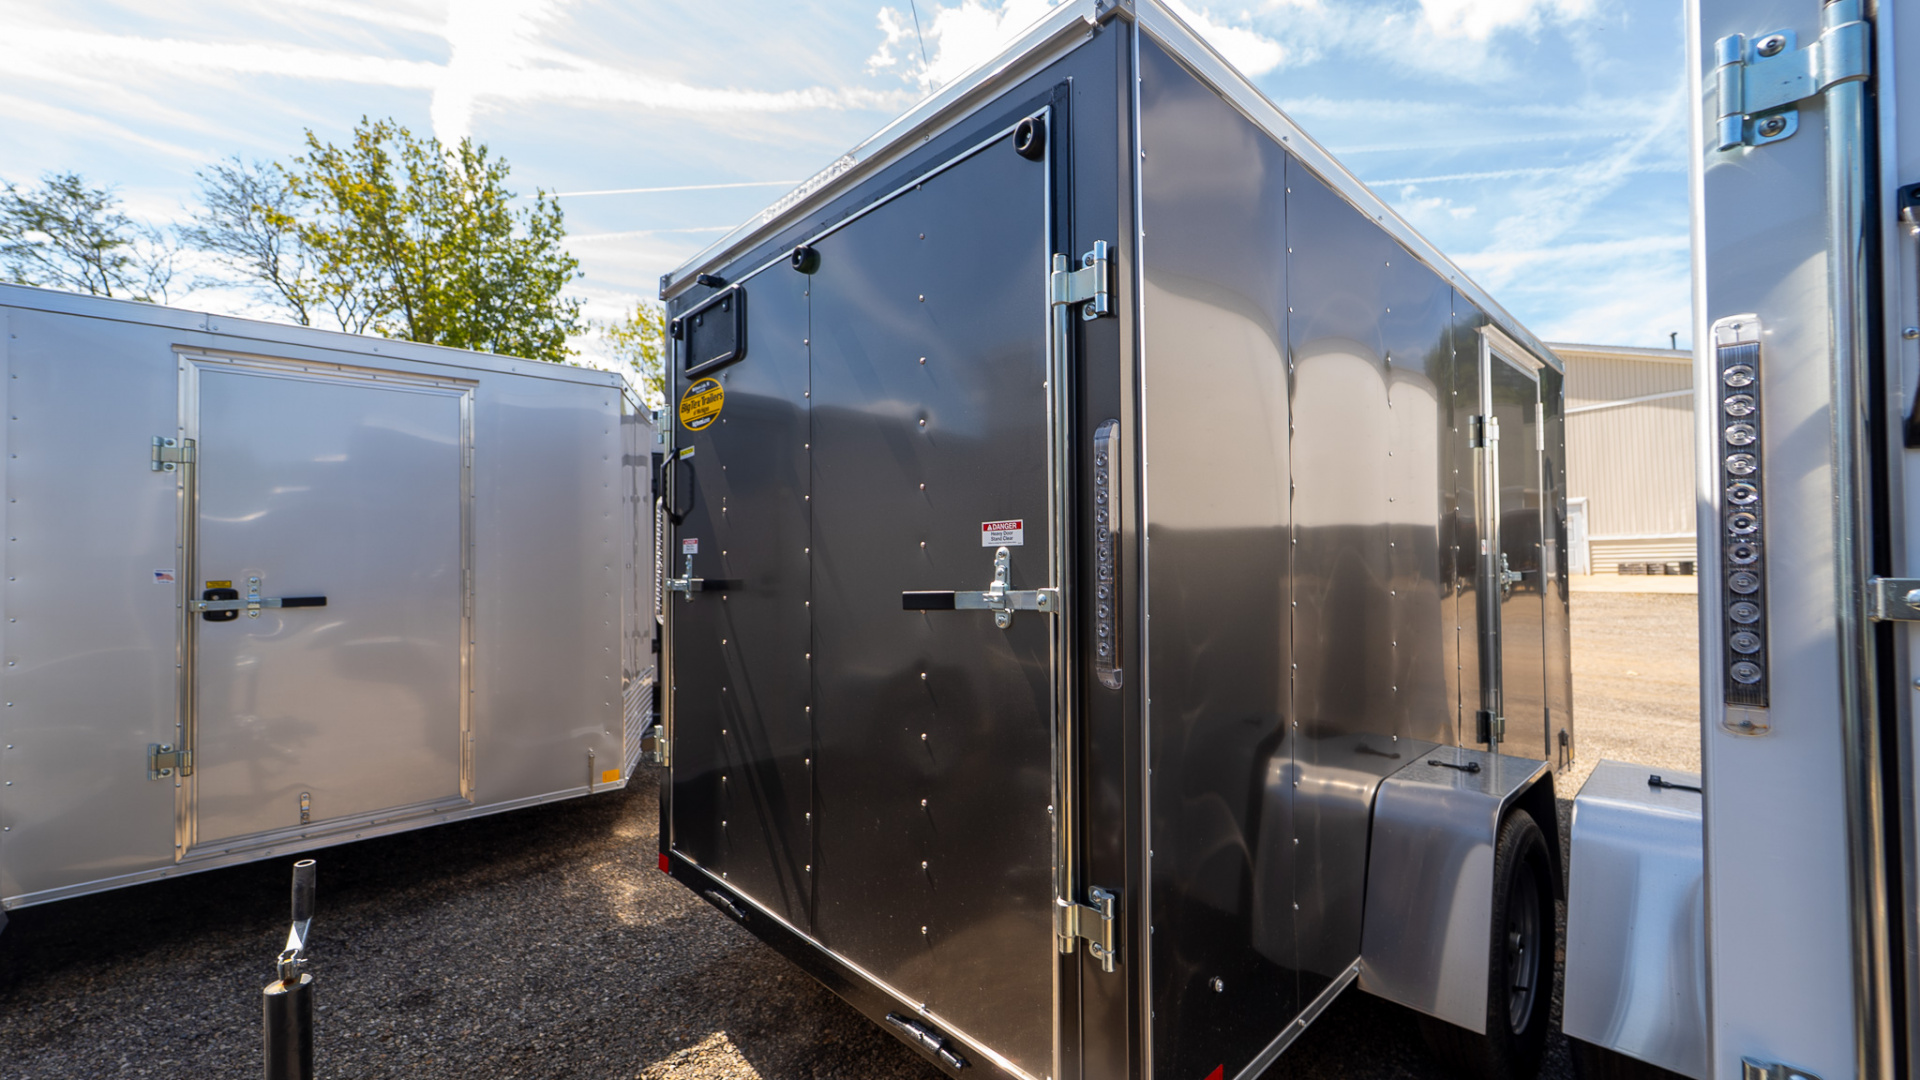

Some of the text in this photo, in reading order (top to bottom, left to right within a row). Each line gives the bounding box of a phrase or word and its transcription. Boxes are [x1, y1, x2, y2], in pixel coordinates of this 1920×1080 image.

[681, 393, 723, 414] Big Tex Trailers
[992, 522, 1017, 530] DANGER
